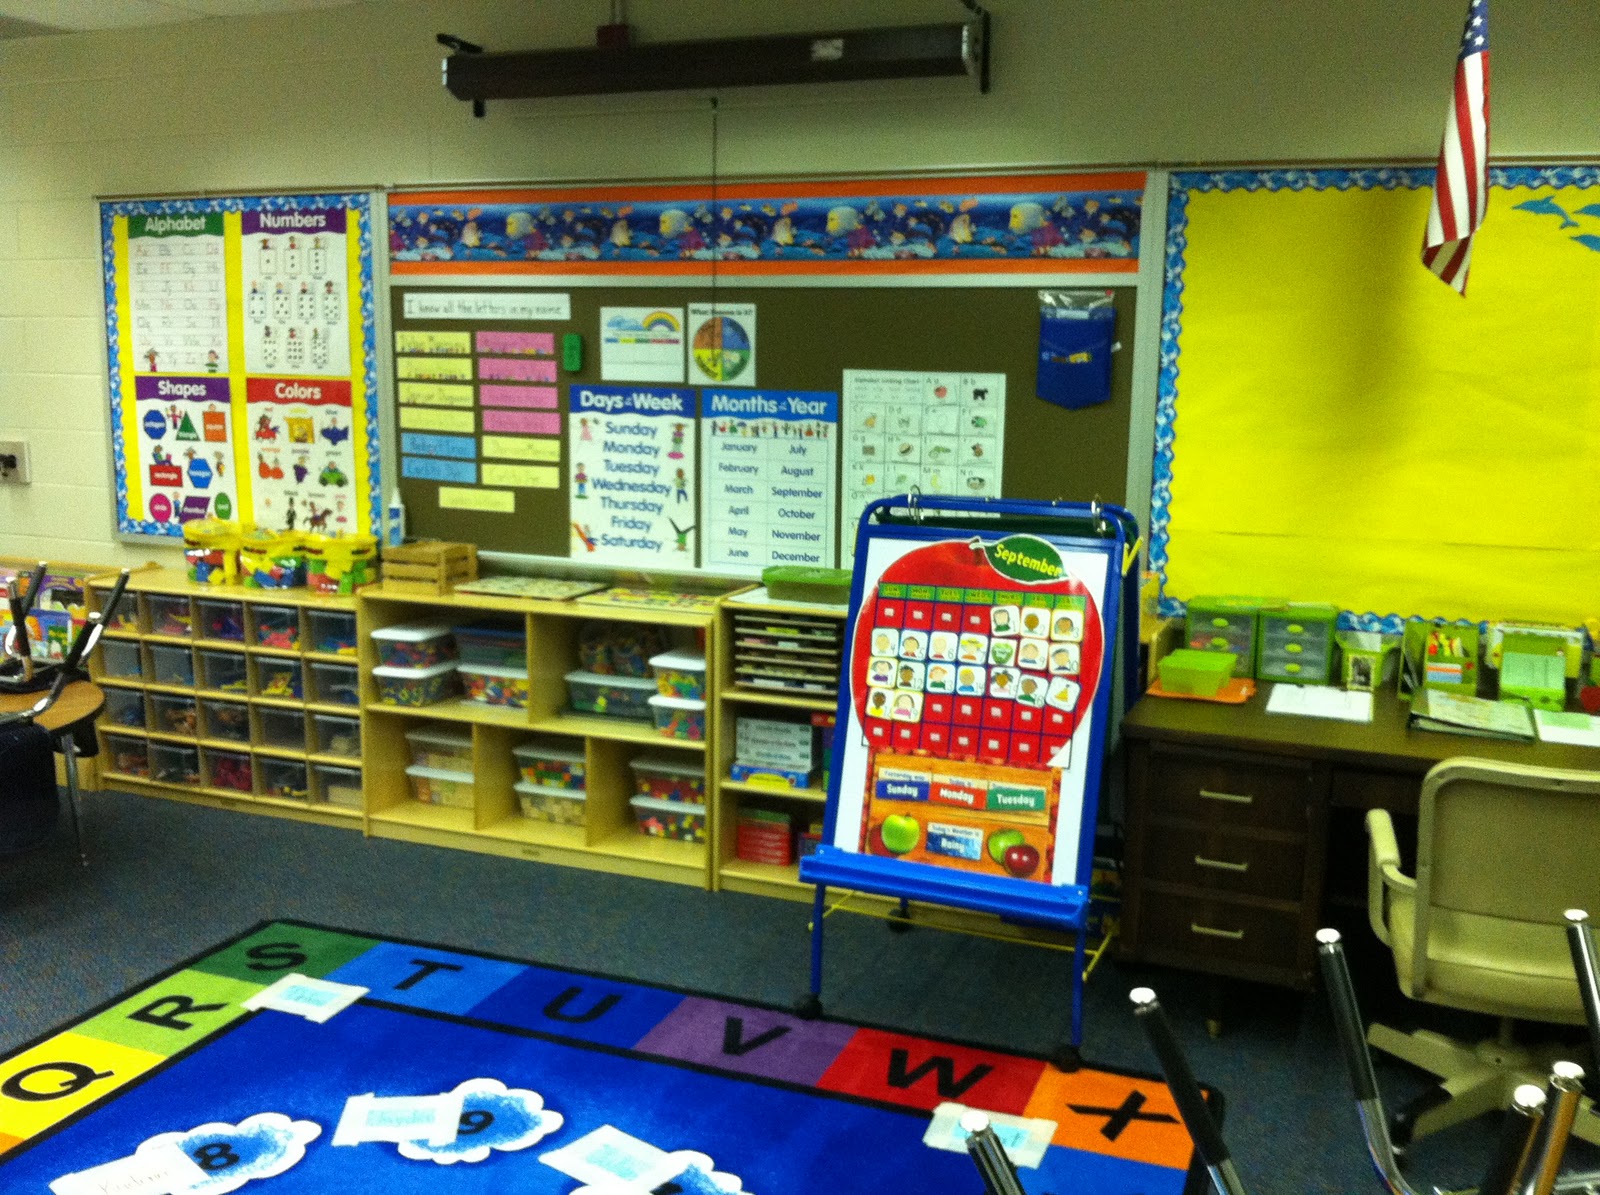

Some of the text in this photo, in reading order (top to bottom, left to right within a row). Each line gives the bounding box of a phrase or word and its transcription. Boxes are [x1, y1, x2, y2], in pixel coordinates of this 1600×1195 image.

[144, 216, 206, 233] Alphabet
[259, 212, 326, 228] Numbers
[407, 300, 413, 314] I
[158, 380, 207, 398] Shapes
[274, 383, 322, 399] Colors
[580, 390, 624, 412] Days
[632, 392, 684, 412] Week
[711, 394, 778, 413] Months
[787, 397, 828, 415] Year
[605, 421, 658, 438] Sunday
[603, 440, 660, 458] Monday
[721, 442, 757, 454] January
[788, 444, 807, 456] July
[603, 459, 659, 477] Tuesday
[718, 462, 759, 475] February
[781, 465, 814, 478] August
[591, 478, 672, 497] Wednesday
[724, 484, 754, 495] March
[771, 486, 823, 499] September
[600, 496, 664, 516] Thursday
[728, 505, 749, 516] April
[778, 508, 816, 520] October
[611, 515, 652, 533] Friday
[728, 526, 748, 538] May
[600, 533, 663, 553] Saturday
[771, 530, 821, 542] November
[728, 548, 749, 558] June
[771, 551, 820, 563] December
[994, 543, 1062, 578] September
[886, 783, 918, 798] Sunday
[939, 787, 974, 804] Monday
[997, 793, 1036, 808] Tuesday
[246, 942, 308, 972] S
[394, 958, 465, 990] T
[126, 994, 230, 1031] R
[543, 986, 623, 1024] U
[722, 1016, 792, 1056] V
[1, 1061, 114, 1102] Q
[886, 1048, 995, 1099] W
[1064, 1090, 1181, 1142] X
[194, 1142, 240, 1171] 8
